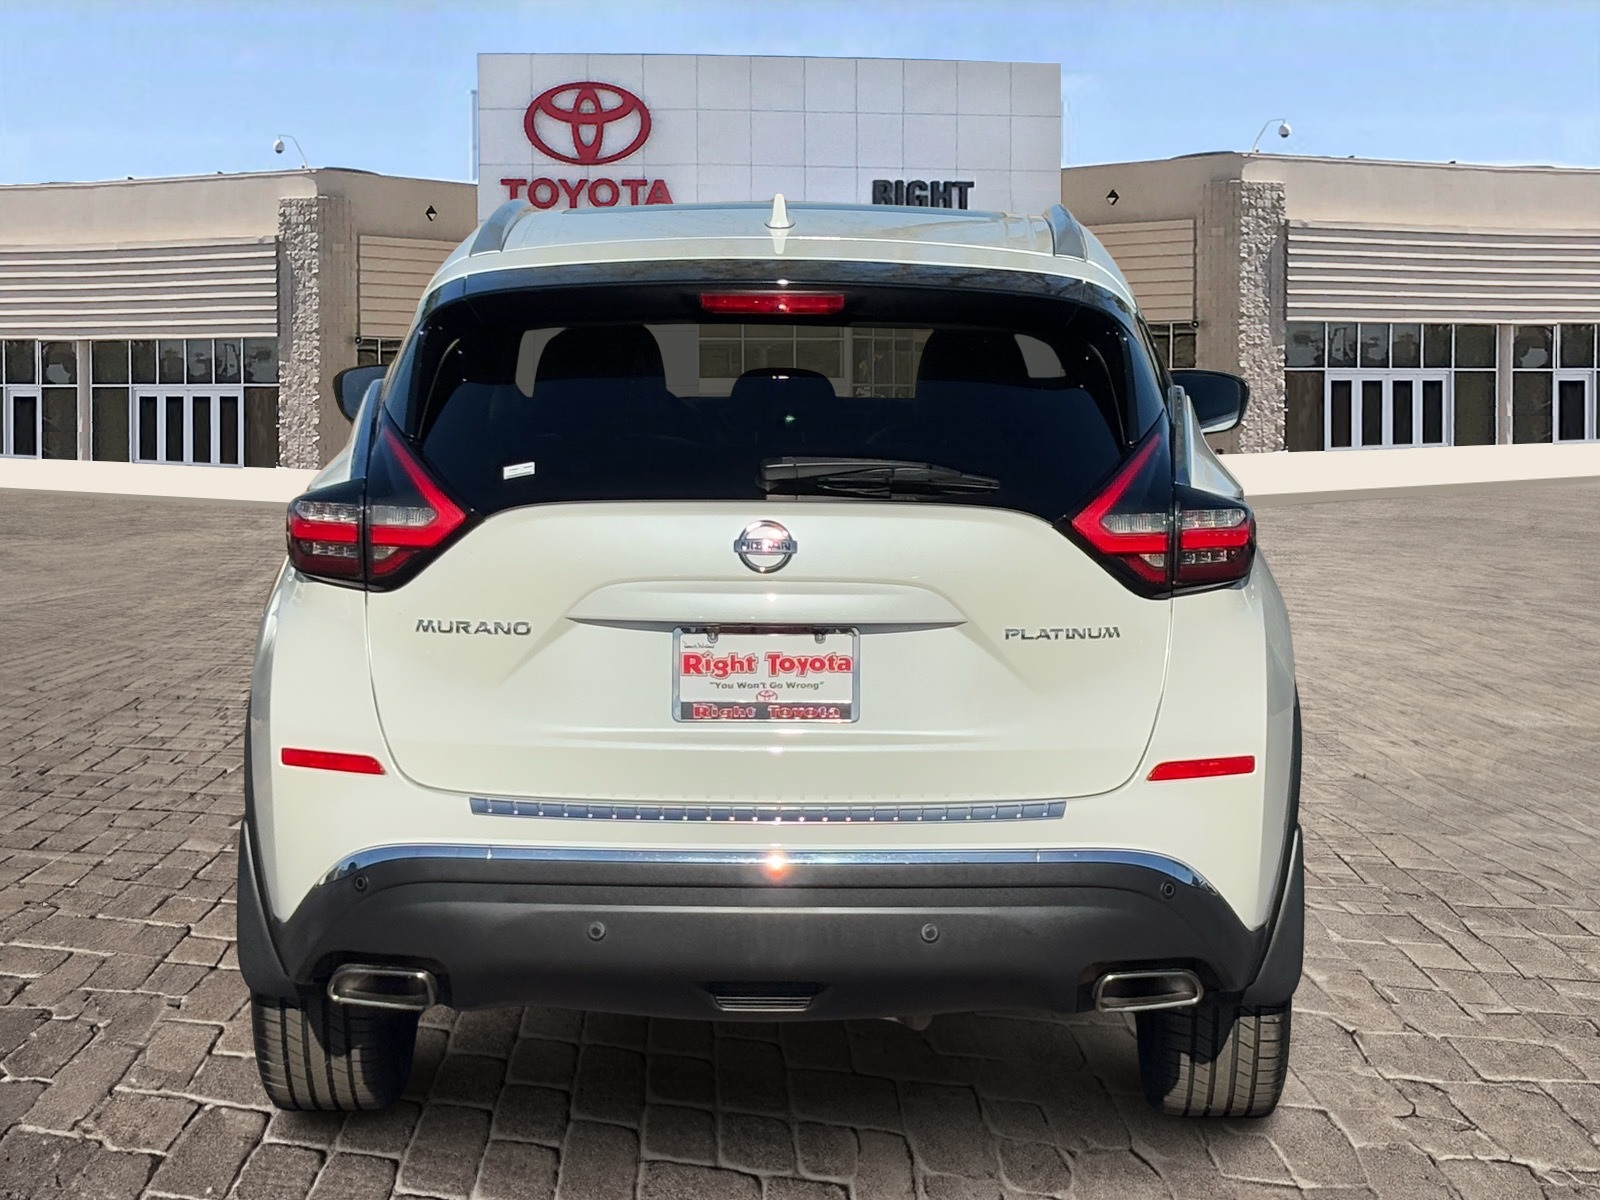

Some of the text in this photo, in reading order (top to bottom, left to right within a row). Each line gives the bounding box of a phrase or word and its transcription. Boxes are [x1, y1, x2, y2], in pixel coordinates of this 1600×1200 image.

[501, 178, 673, 209] TOYOTA
[872, 180, 974, 209] RIGHT
[741, 541, 791, 550] NISAN
[415, 619, 531, 635] MURANO
[1004, 627, 1120, 640] PLATINUM
[682, 651, 853, 680] Right Toyota
[736, 682, 767, 690] Won't
[693, 703, 841, 719] Right Toyota
